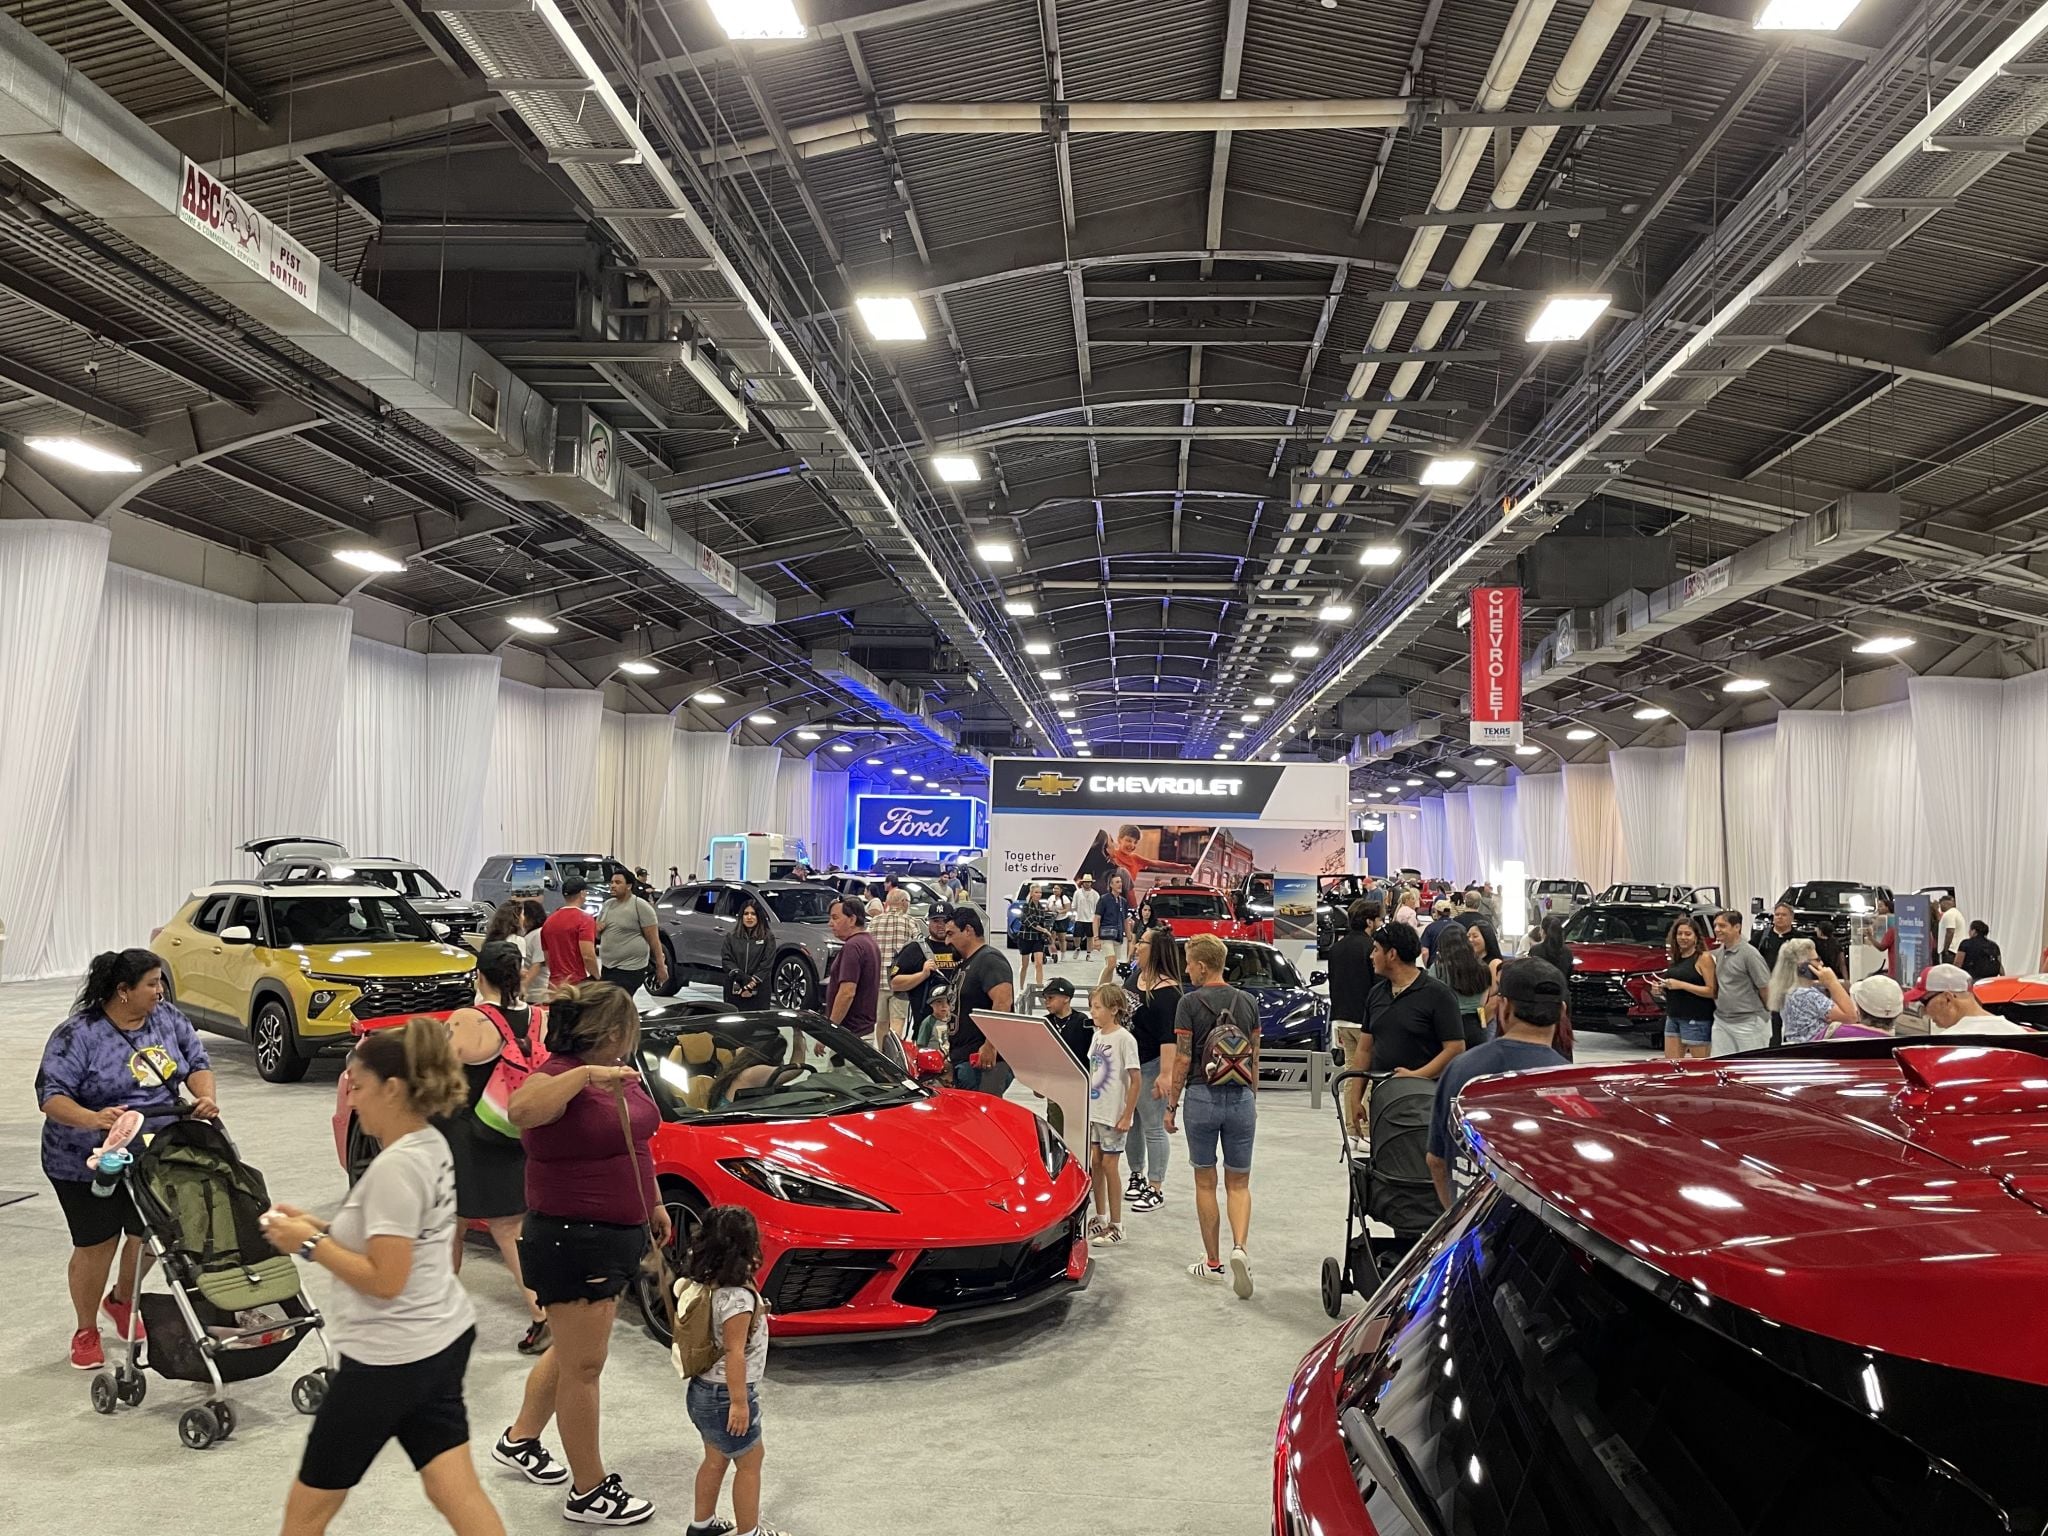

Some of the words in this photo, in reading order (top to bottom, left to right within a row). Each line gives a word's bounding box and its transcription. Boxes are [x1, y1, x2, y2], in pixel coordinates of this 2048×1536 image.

[182, 163, 222, 229] ABC
[202, 225, 237, 256] COMMERCIAL
[236, 250, 260, 271] SERVICES
[280, 247, 301, 272] PEST
[270, 260, 307, 298] CONTROL
[1488, 590, 1504, 721] CHEVROLET
[1483, 727, 1511, 735] TEXAS
[1088, 775, 1244, 797] CHEVROLET
[879, 807, 952, 838] Ford
[1004, 850, 1056, 862] Together
[1004, 862, 1028, 872] let's
[1030, 862, 1059, 873] drive
